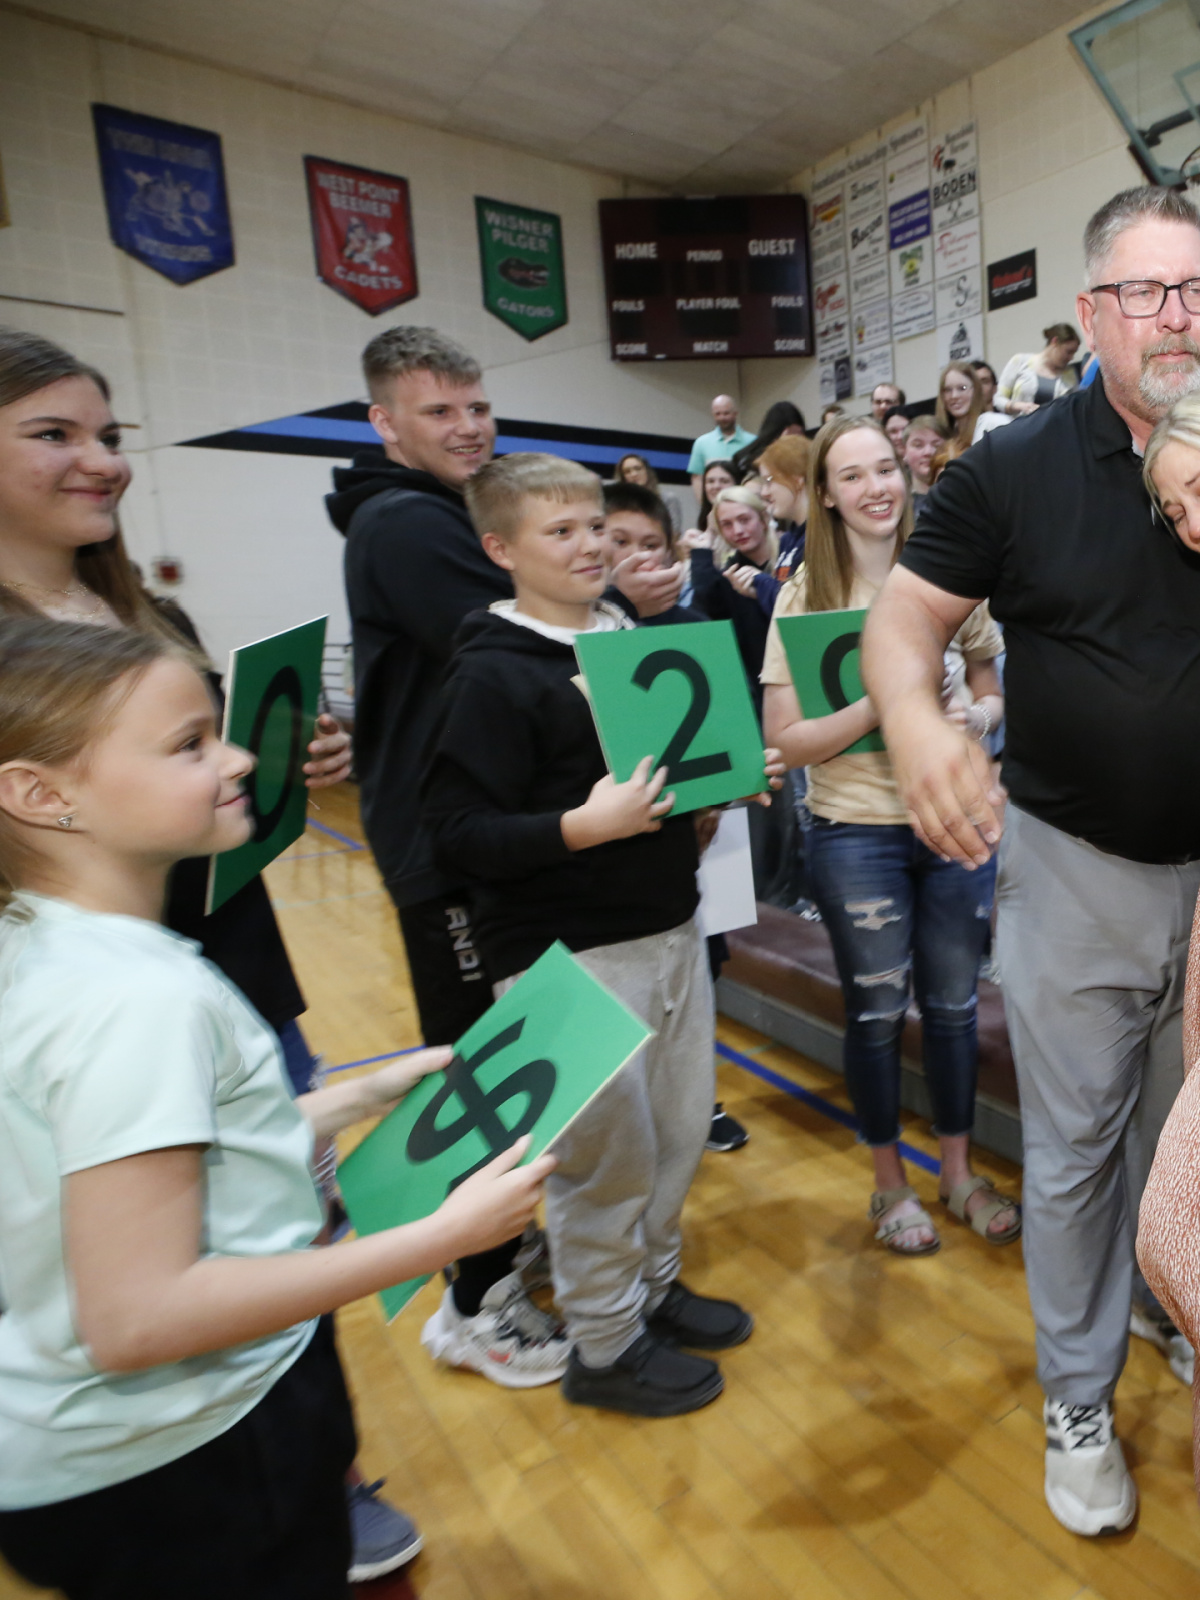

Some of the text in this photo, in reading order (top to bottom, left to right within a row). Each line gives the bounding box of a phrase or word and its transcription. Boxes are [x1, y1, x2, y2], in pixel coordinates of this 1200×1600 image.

[316, 172, 399, 202] WEST POINT
[933, 170, 977, 200] BODEN
[329, 192, 391, 218] BEEMER
[484, 211, 553, 238] WISNER
[492, 229, 549, 254] PILGER
[615, 242, 658, 259] HOME
[748, 239, 796, 257] GUEST
[687, 249, 723, 262] PERIOD
[334, 266, 403, 289] CADETS
[497, 297, 555, 318] GATORS
[612, 300, 645, 312] FOULS
[676, 297, 741, 310] PLAYER FOUL
[771, 296, 804, 308] FOULS
[616, 343, 648, 355] SCORE
[693, 341, 728, 353] MATCH
[774, 339, 806, 351] SCORE
[631, 649, 733, 787] 2
[444, 907, 483, 982] AND1
